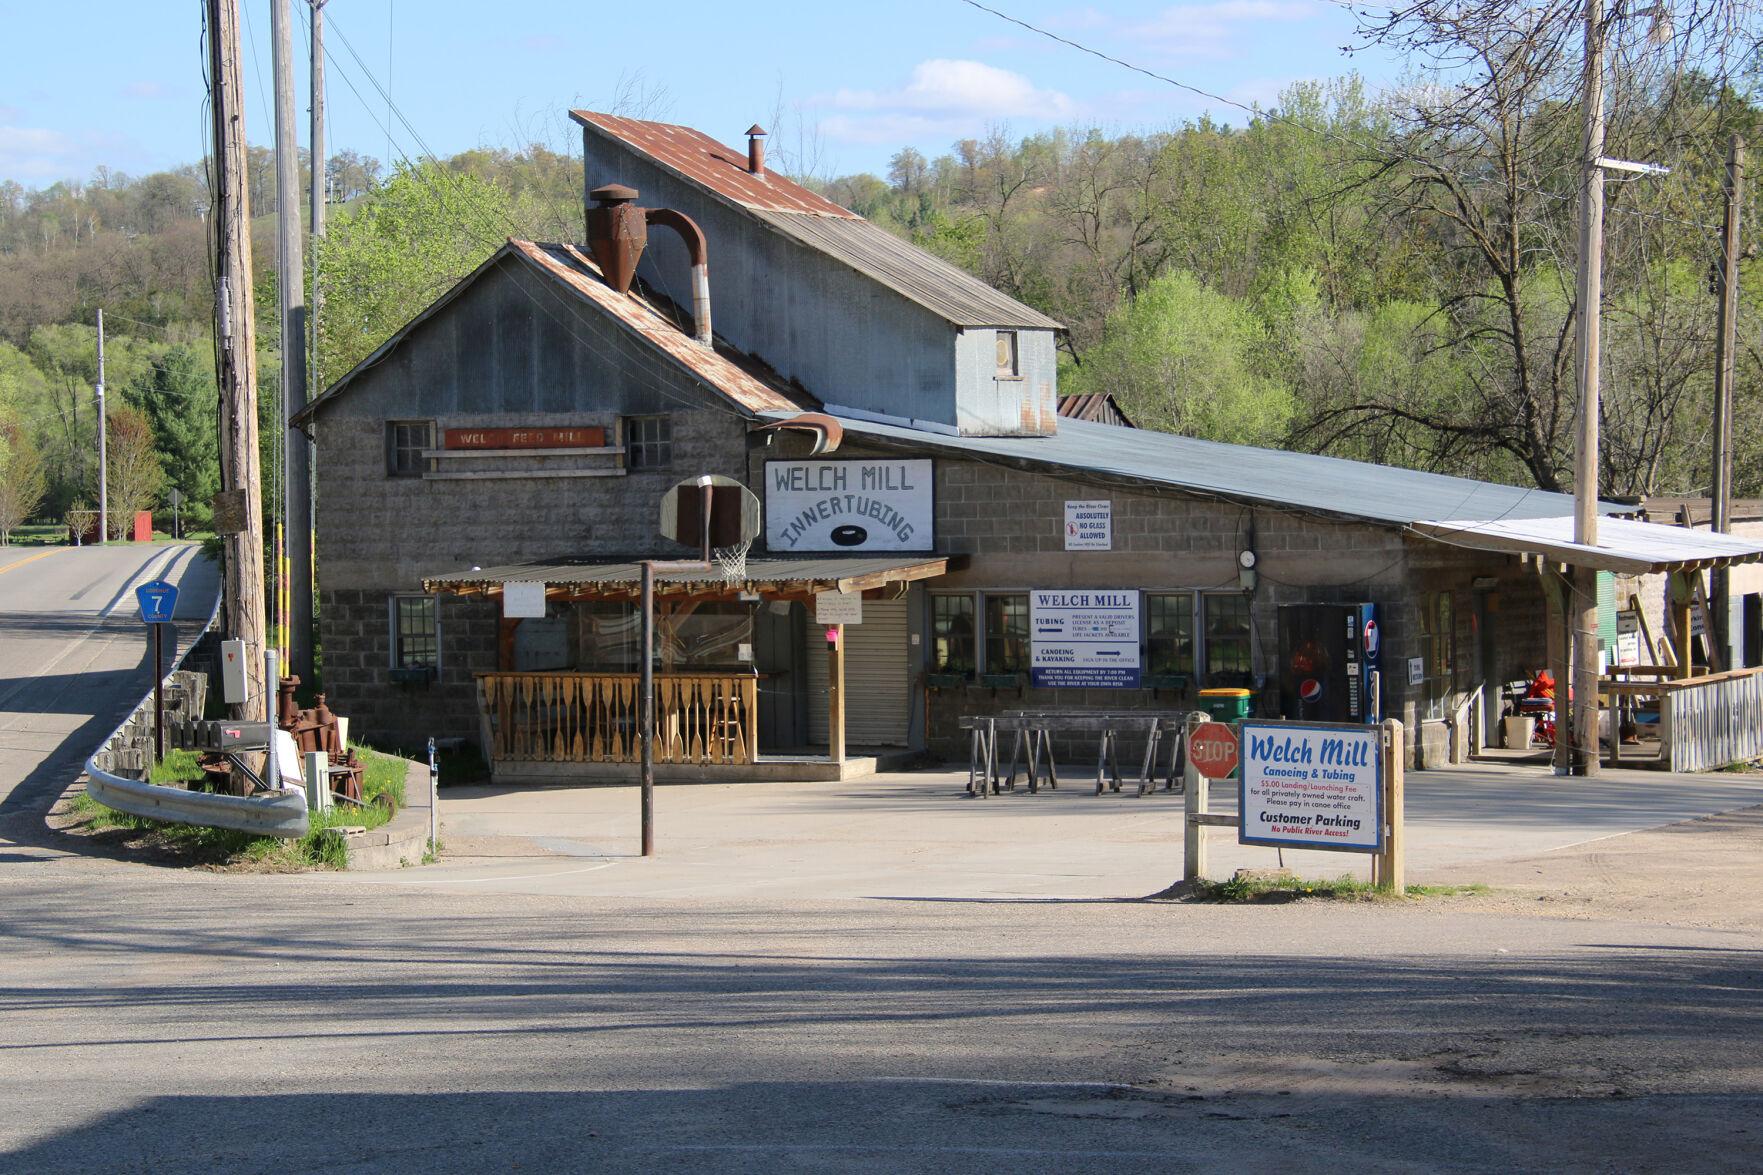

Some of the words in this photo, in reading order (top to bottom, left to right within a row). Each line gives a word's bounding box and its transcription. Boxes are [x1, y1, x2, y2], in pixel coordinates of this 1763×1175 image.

[775, 467, 846, 491] WELCH
[862, 466, 914, 490] MILL
[780, 494, 914, 548] INNERTUBING
[152, 596, 162, 611] 7
[1039, 595, 1089, 606] WELCH
[1095, 595, 1130, 606] MILL
[1193, 740, 1235, 762] STOP
[1251, 735, 1312, 765] Welch
[1320, 738, 1368, 767] Mill
[1264, 766, 1308, 779] Canoeing
[1311, 769, 1318, 778] &
[1322, 769, 1355, 782] Tubing
[1272, 790, 1300, 798] privately
[1281, 782, 1343, 793] Landing/Launching
[1333, 801, 1351, 809] office
[1260, 811, 1312, 825] Customer
[1315, 815, 1360, 830] Parking
